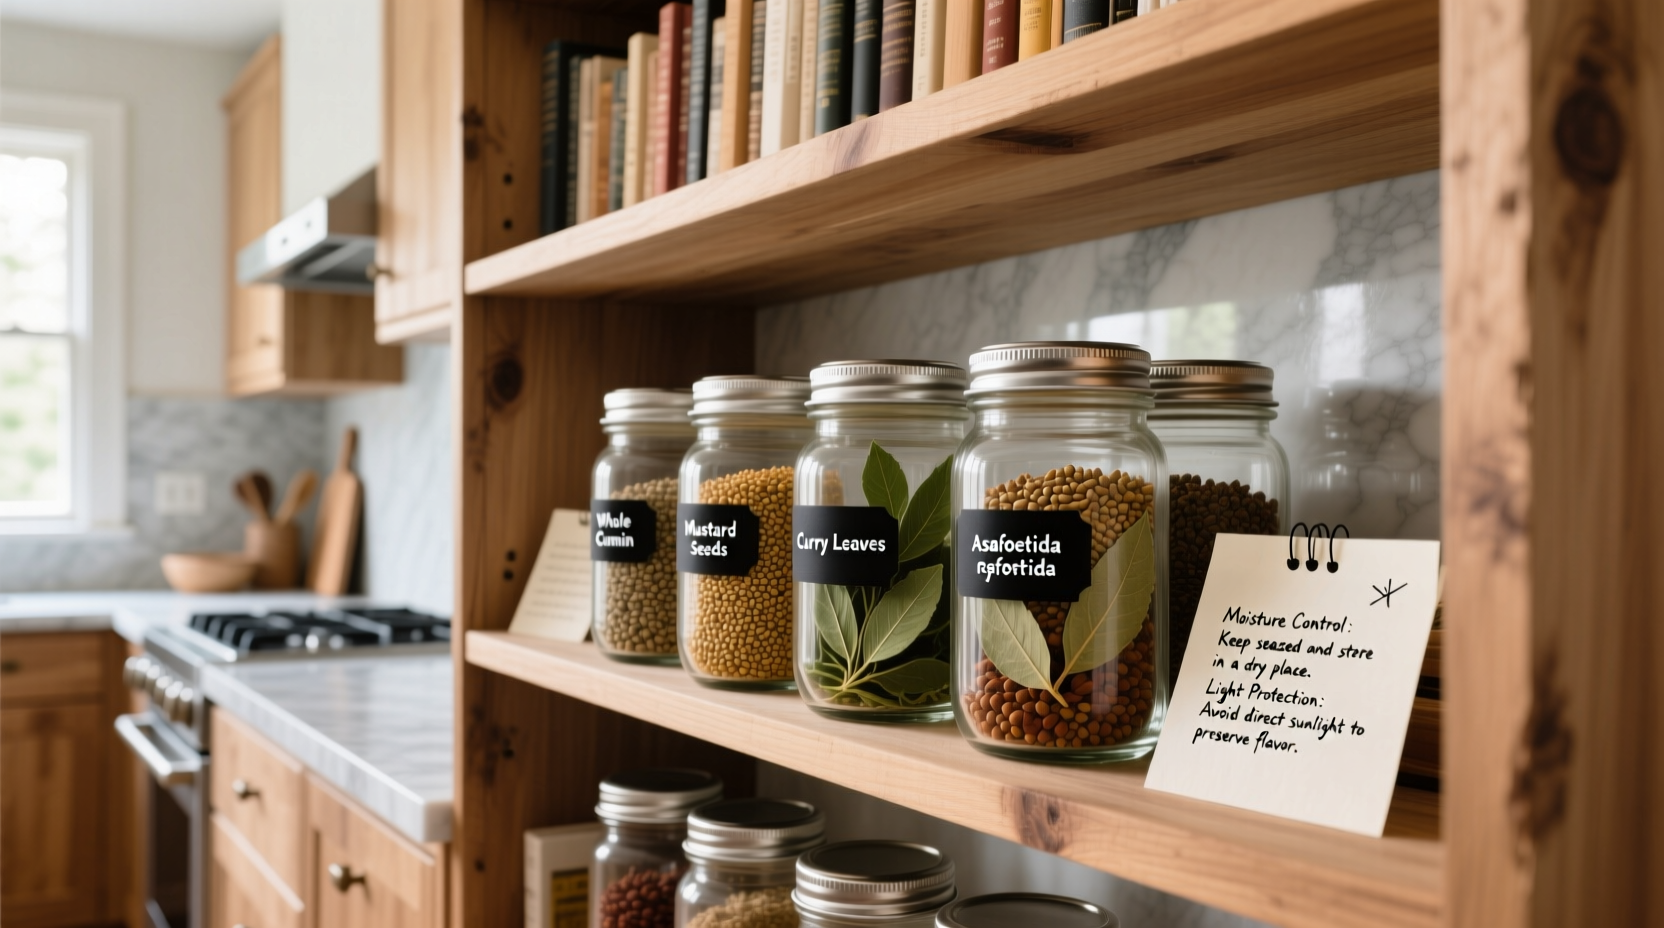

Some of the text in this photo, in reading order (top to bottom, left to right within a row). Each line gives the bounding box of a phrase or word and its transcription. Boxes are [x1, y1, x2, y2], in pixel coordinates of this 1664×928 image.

[596, 512, 632, 529] Whole
[685, 519, 737, 538] Mustard
[595, 532, 634, 548] Cumin
[690, 540, 728, 557] Seeds
[796, 531, 886, 556] Curry Leaves
[971, 533, 1062, 554] Asafoetida
[1222, 606, 1352, 633] Moisture Control:
[1217, 630, 1251, 654] Keep
[1307, 641, 1335, 656] and
[1212, 653, 1312, 680] in a dry place.
[1205, 678, 1324, 707] Light Protection:
[1199, 701, 1366, 740] Avoid direct sunlight to
[1191, 727, 1298, 753] preserve flavor.
